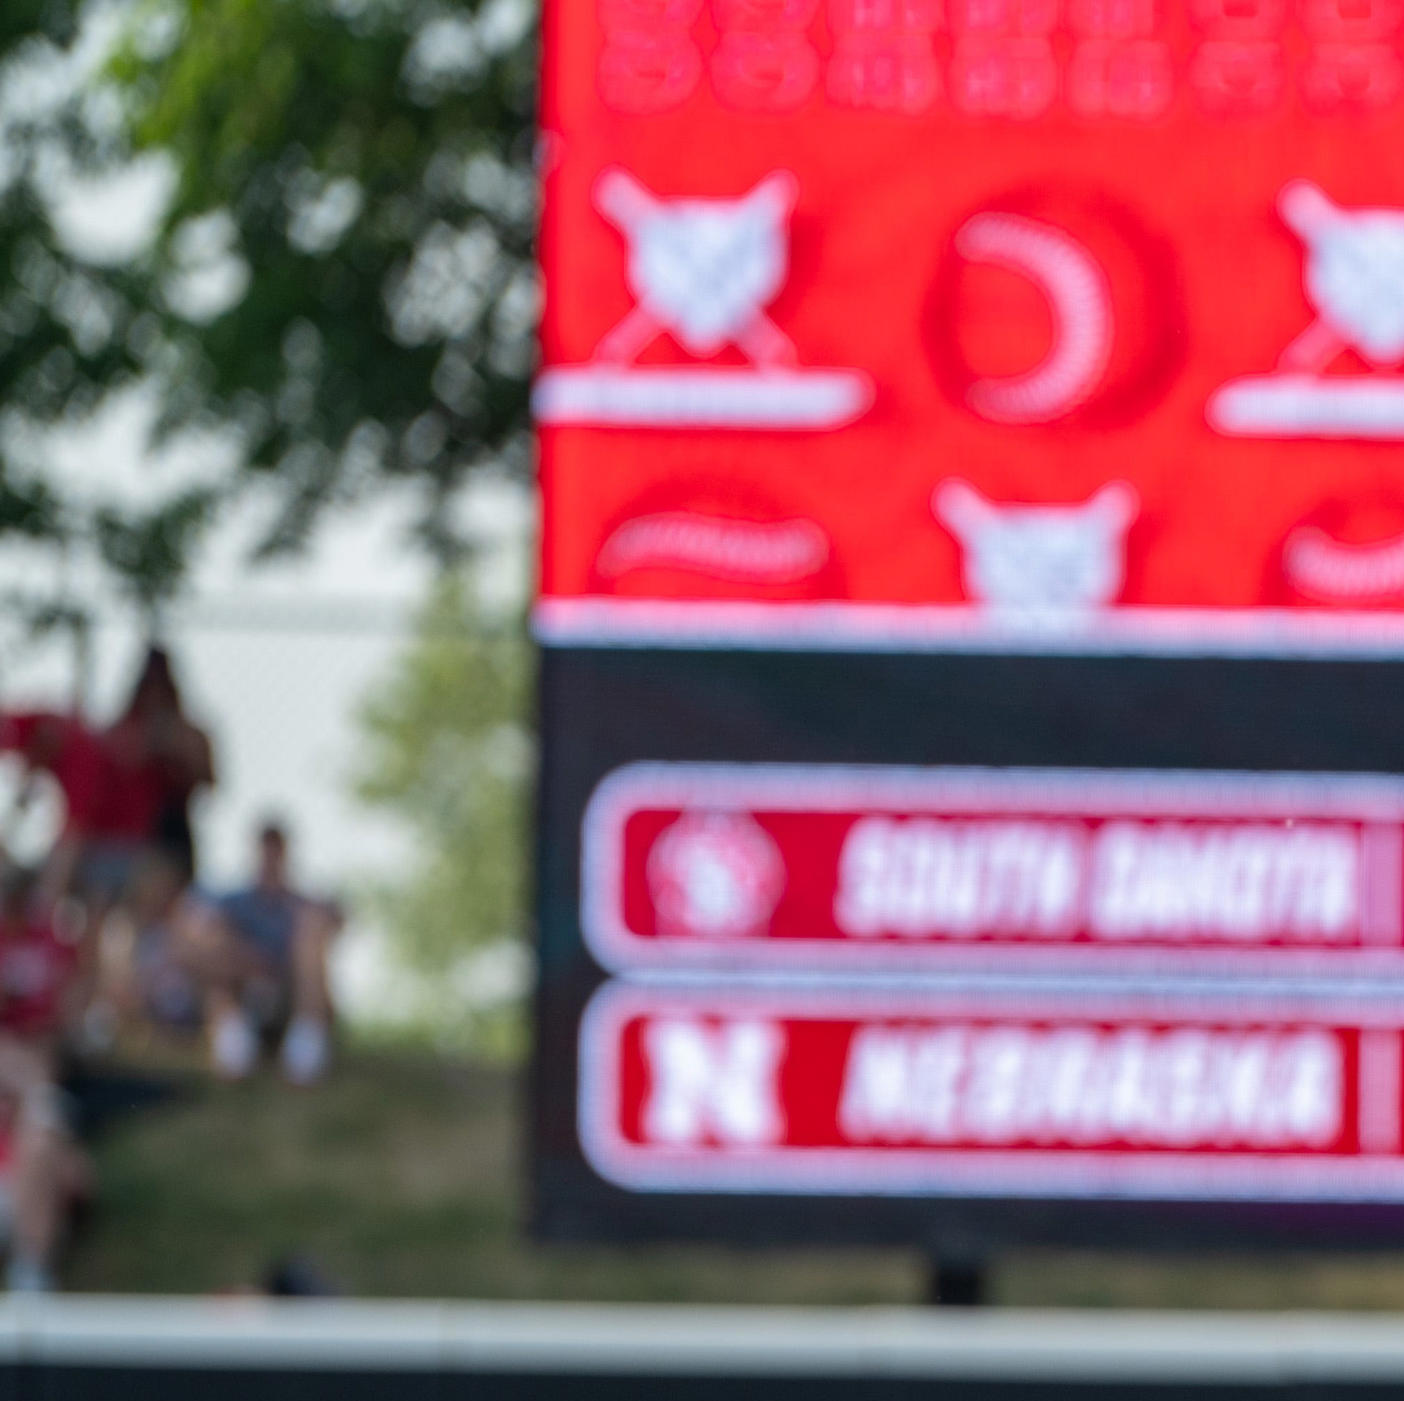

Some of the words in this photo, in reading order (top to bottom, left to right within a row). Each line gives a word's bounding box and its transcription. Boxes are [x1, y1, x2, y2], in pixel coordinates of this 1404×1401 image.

[834, 816, 1083, 940] SOUTH
[642, 1012, 786, 1149] N
[837, 1025, 1343, 1149] NEBRASKA
